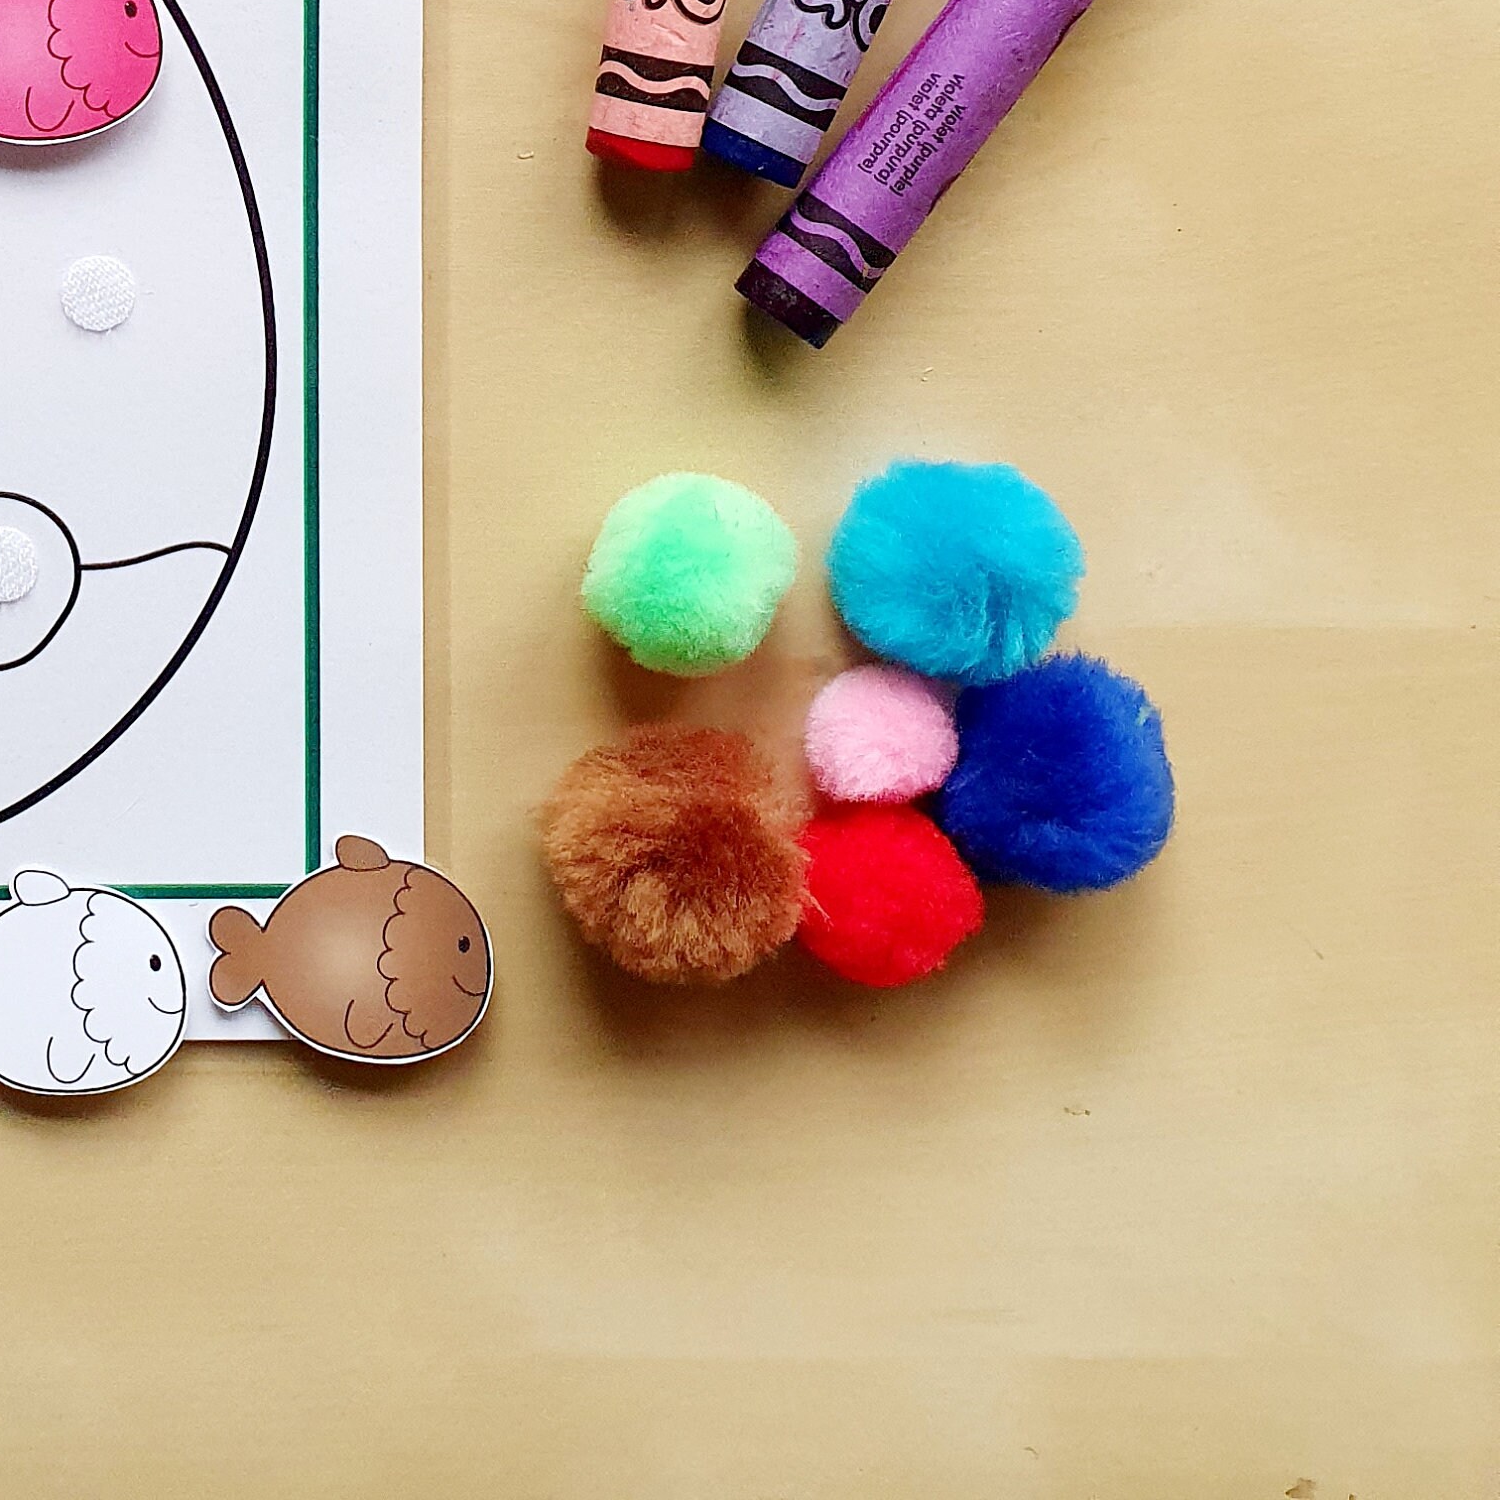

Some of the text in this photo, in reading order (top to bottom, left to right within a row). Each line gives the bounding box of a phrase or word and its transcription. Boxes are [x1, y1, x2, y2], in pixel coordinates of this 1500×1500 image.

[908, 73, 941, 111] violet
[923, 73, 965, 120] violeta
[889, 104, 968, 197] violet (purple)
